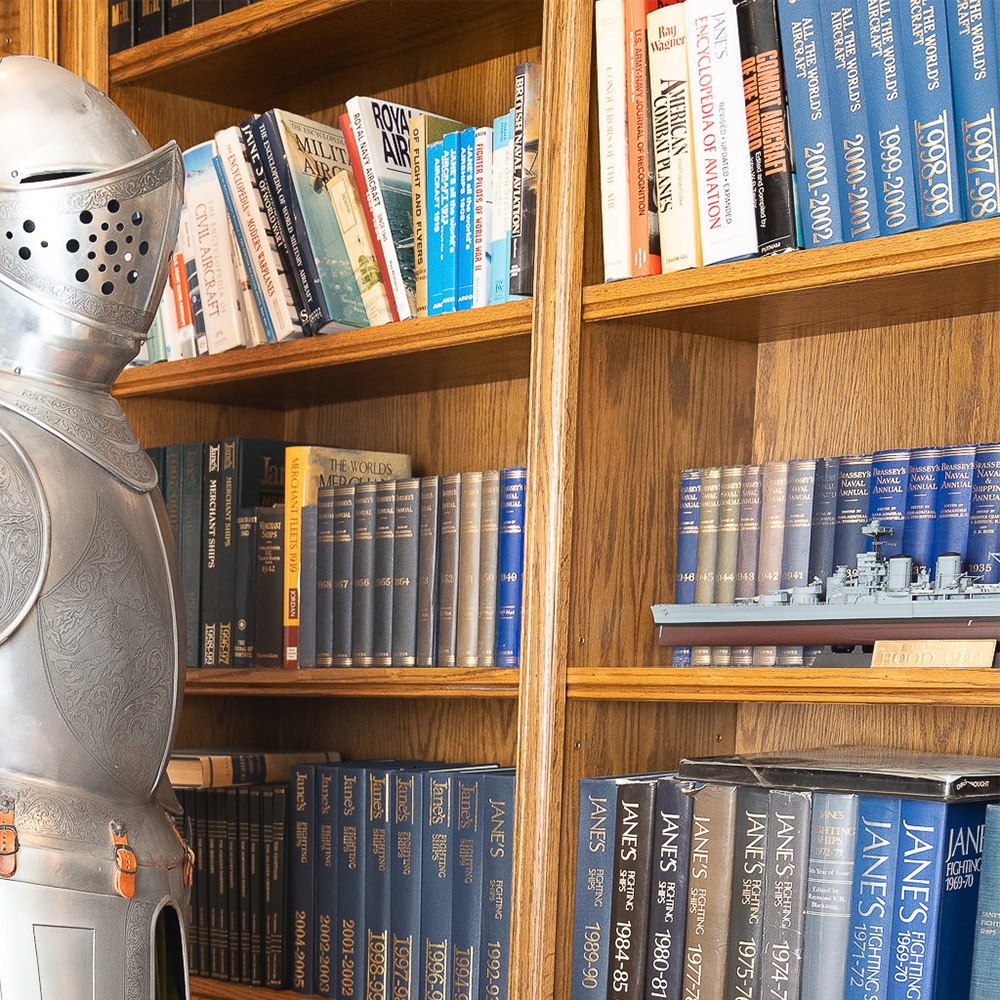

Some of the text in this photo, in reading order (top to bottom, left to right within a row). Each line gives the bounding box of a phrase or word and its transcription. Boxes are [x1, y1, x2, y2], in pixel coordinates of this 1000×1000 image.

[651, 36, 686, 52] Wagner
[659, 25, 676, 38] Ray
[712, 12, 728, 59] JANE'S
[791, 22, 807, 78] AIRCRAFT
[831, 11, 846, 69] AIRCRAFT
[842, 8, 861, 113] ALL THE WORLD'S
[881, 18, 898, 101] THE WORLD'S
[922, 6, 940, 91] THE WORLD'S
[802, 18, 822, 121] ALL THE WORLD'S
[413, 129, 419, 143] OF
[634, 29, 646, 216] U.S. ARMY-NAVY JOURNAL OF RECOGNITION
[660, 79, 688, 156] AMERICAN
[695, 16, 721, 230] ENCYCLOPEDIA OF AVIATION
[756, 50, 786, 176] COMBAT AIRCRAFT
[353, 113, 363, 140] ROYAL
[360, 142, 370, 165] NAVY
[366, 168, 381, 207] AIRCRAFT
[413, 148, 421, 187] FLIGHT
[654, 96, 672, 213] COMBAT PLANES
[878, 124, 907, 228] 1999-2000
[917, 114, 950, 217] 1998-99
[964, 112, 997, 218] 1997-98
[259, 123, 313, 303] THE ENCYCLOPEDIA OF WORLD MILITARY AIRCRAFT
[475, 205, 483, 214] OF
[804, 142, 834, 244] 2001-2002
[843, 133, 871, 238] 2000-2001
[195, 203, 219, 317] CIVIL AIRCRAFT
[416, 221, 424, 265] FLYERS
[291, 457, 299, 514] MERCHANT
[329, 458, 346, 472] THE
[840, 471, 871, 479] BRASSEY'S
[873, 467, 906, 476] BRASSEY'S
[908, 464, 941, 474] BRASSEY'S
[941, 462, 975, 471] BRASSEY'S
[208, 480, 217, 568] MERCHANT SHIPS
[290, 517, 299, 550] FLEETS
[969, 564, 992, 572] 1935
[881, 650, 984, 666] HOOD 1941
[589, 796, 607, 852] JANE'S
[622, 801, 639, 861] JANE'S
[660, 811, 680, 872] JANE'S
[692, 814, 711, 879] JANE'S
[744, 811, 767, 874] JANE'S
[775, 812, 796, 877] JANE'S
[588, 869, 596, 892] SHIPS
[596, 869, 605, 906] FIGHTING
[619, 869, 627, 892] SHIPS
[626, 871, 635, 911] FIGHTING
[657, 881, 666, 904] SHIPS
[742, 879, 751, 904] SHIPS
[773, 879, 783, 906] SHIPS
[858, 819, 892, 918] JANE'S
[899, 820, 935, 926] JANE'S
[945, 874, 974, 891] 1969-70
[665, 882, 675, 922] FIGHTING
[689, 888, 698, 913] SHIPS
[695, 889, 706, 935] FIGHTING
[749, 880, 761, 924] FIGHTING
[781, 881, 792, 927] FIGHTING
[294, 911, 306, 988] 2004-2005
[319, 915, 331, 993] 2002-2003
[342, 919, 354, 997] 2001-2002
[581, 922, 601, 989] 1989-90
[613, 921, 632, 992] 1984-85
[651, 931, 672, 998] 1980-81
[849, 923, 867, 988] 1971-72
[863, 925, 884, 1000] FIGHTING
[893, 930, 912, 982] 1969-70
